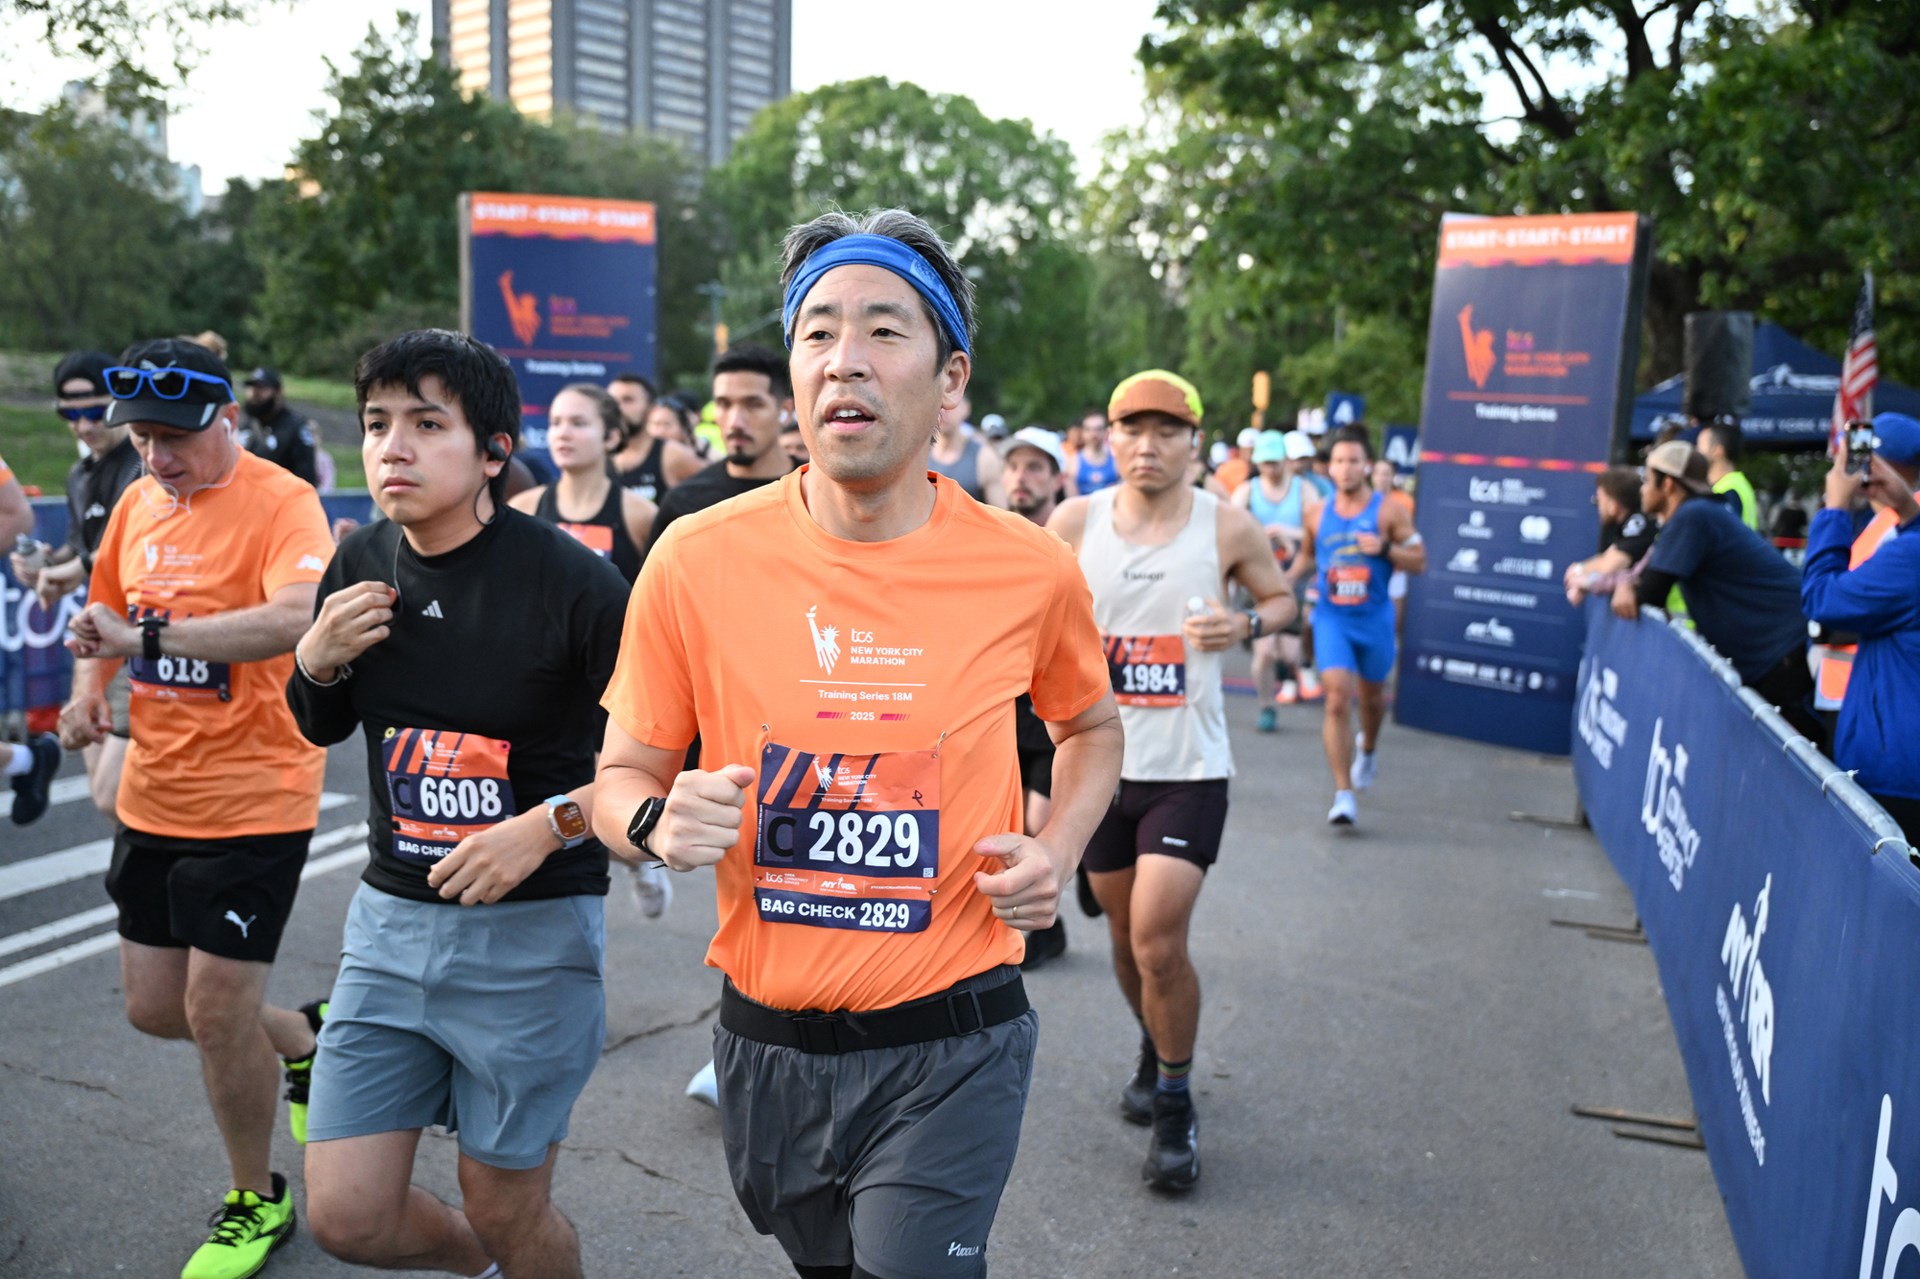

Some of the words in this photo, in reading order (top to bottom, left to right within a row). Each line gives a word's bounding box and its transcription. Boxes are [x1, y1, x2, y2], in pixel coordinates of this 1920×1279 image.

[851, 628, 874, 643] tcs
[851, 646, 874, 655] NEW
[875, 647, 901, 656] YORK
[902, 648, 923, 656] CITY
[850, 656, 906, 666] MARATHON
[1122, 663, 1178, 693] 1984
[818, 689, 857, 701] Training
[859, 691, 890, 701] Series
[892, 692, 913, 701] 18M
[850, 711, 875, 721] 2025
[420, 776, 503, 819] 6608
[767, 815, 797, 858] C
[808, 811, 920, 868] 2829
[398, 840, 420, 854] BAG
[421, 844, 457, 857] CHEC
[765, 871, 783, 884] tcs
[761, 897, 795, 915] BAG
[798, 902, 856, 920] CHECK
[859, 902, 910, 929] 2829
